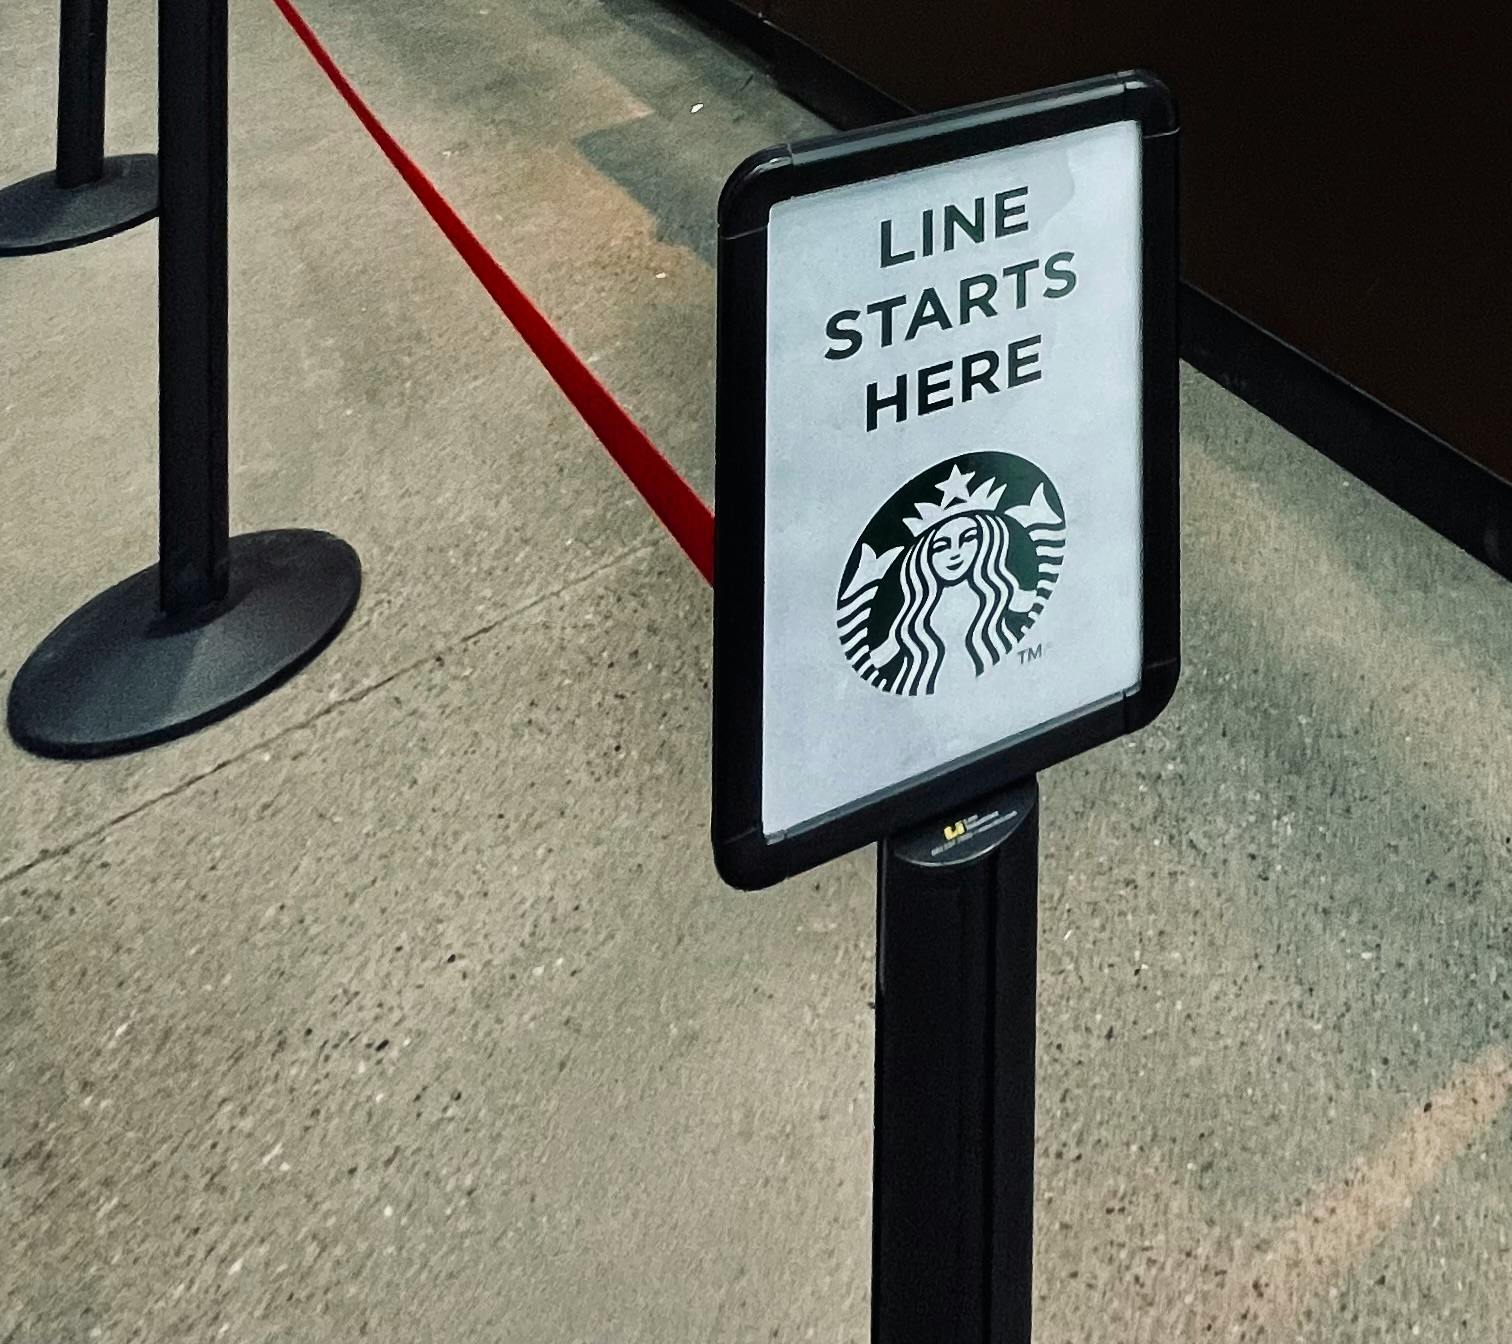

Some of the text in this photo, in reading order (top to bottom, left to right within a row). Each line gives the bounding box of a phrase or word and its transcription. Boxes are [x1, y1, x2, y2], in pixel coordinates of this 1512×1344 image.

[880, 185, 1031, 269] LINE
[823, 250, 1078, 360] STARTS
[865, 333, 1043, 432] HERE
[1017, 643, 1042, 664] TM
